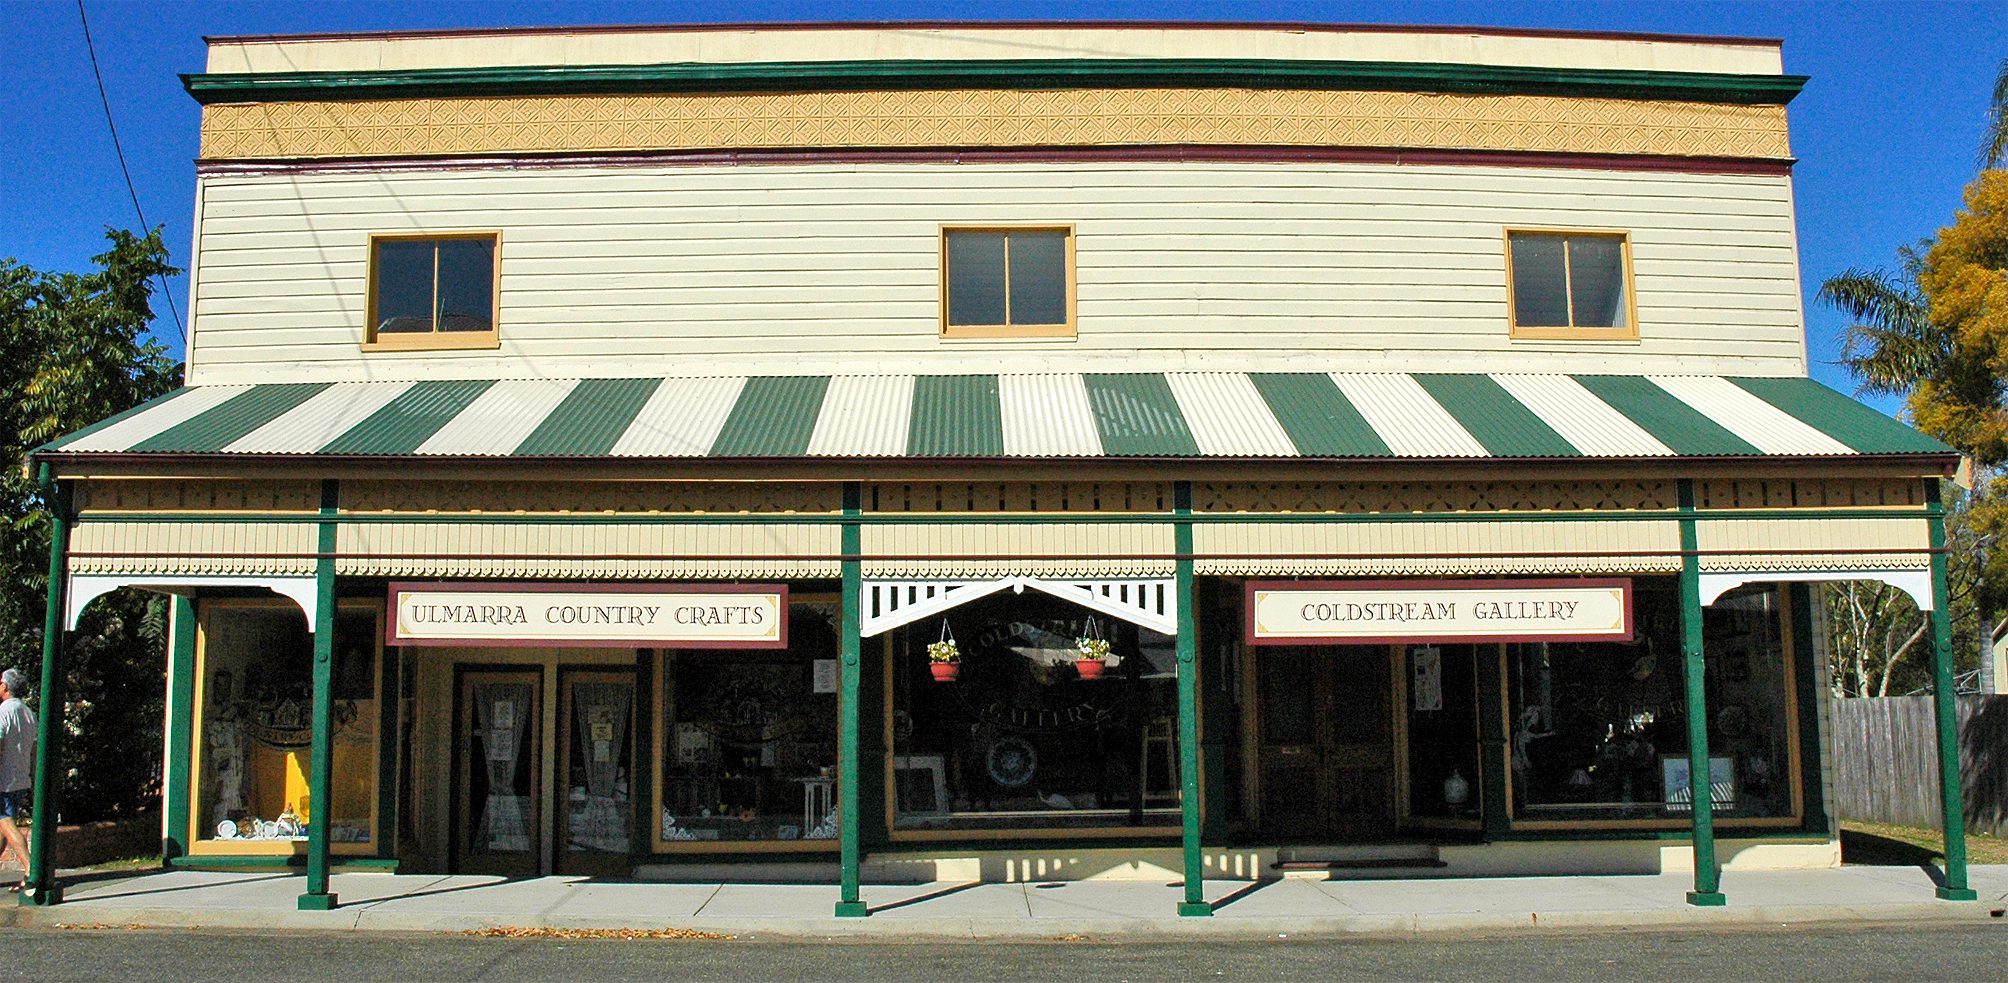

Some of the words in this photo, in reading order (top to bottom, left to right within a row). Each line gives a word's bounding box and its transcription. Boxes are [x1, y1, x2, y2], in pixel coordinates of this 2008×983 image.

[412, 605, 528, 625] ULMARRA
[544, 606, 661, 625] COUNTRY
[674, 606, 764, 626] CRAFTS
[1300, 602, 1457, 623] COLDSTREAM
[1473, 601, 1579, 621] GALLERY
